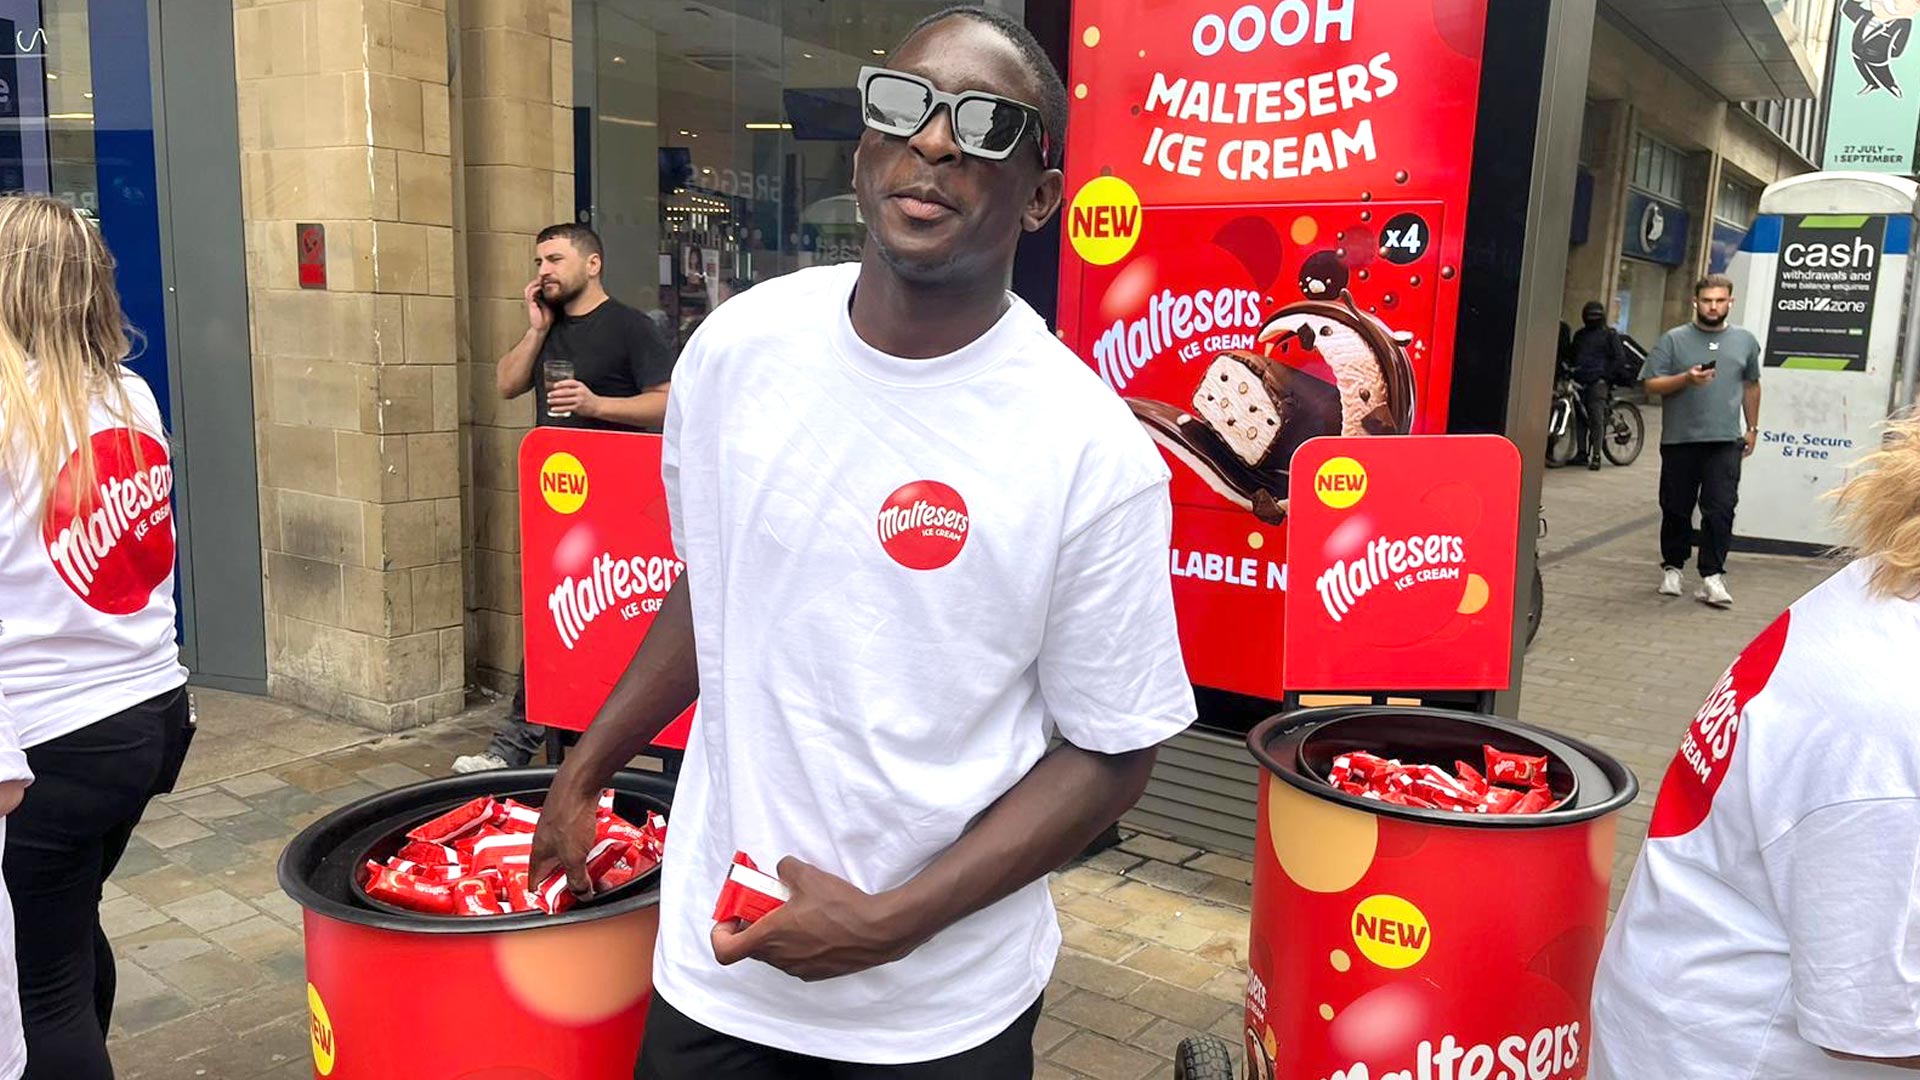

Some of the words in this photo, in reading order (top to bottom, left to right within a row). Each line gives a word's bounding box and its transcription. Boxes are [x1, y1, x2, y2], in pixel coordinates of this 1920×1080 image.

[1192, 0, 1355, 56] OOOH
[1144, 51, 1398, 124] MALTESERS
[1142, 127, 1207, 177] ICE
[1217, 119, 1376, 181] CREAM
[1840, 155, 1903, 163] SEPTEMBER
[1844, 145, 1856, 153] 27
[1857, 145, 1884, 153] JULY
[1072, 205, 1138, 238] NEW
[1384, 223, 1421, 254] x4
[1784, 236, 1875, 268] cash
[1782, 269, 1847, 281] withdrawals
[1849, 271, 1871, 281] and
[1093, 288, 1263, 393] Maltesers
[1178, 341, 1201, 363] ICE
[1204, 334, 1255, 352] CREAM
[1782, 446, 1793, 457] &
[1797, 448, 1829, 460] Free
[1803, 434, 1853, 448] Secure
[543, 472, 585, 495] NEW
[1318, 474, 1365, 492] NEW
[134, 519, 149, 541] ICE
[879, 500, 968, 542] Maltesers
[922, 529, 934, 537] ICE
[936, 529, 961, 542] CREAM
[1316, 534, 1464, 622] Maltesers
[1394, 574, 1415, 591] ICE
[1416, 568, 1459, 582] CREAM
[620, 602, 640, 620] ICE
[1355, 913, 1427, 949] NEW
